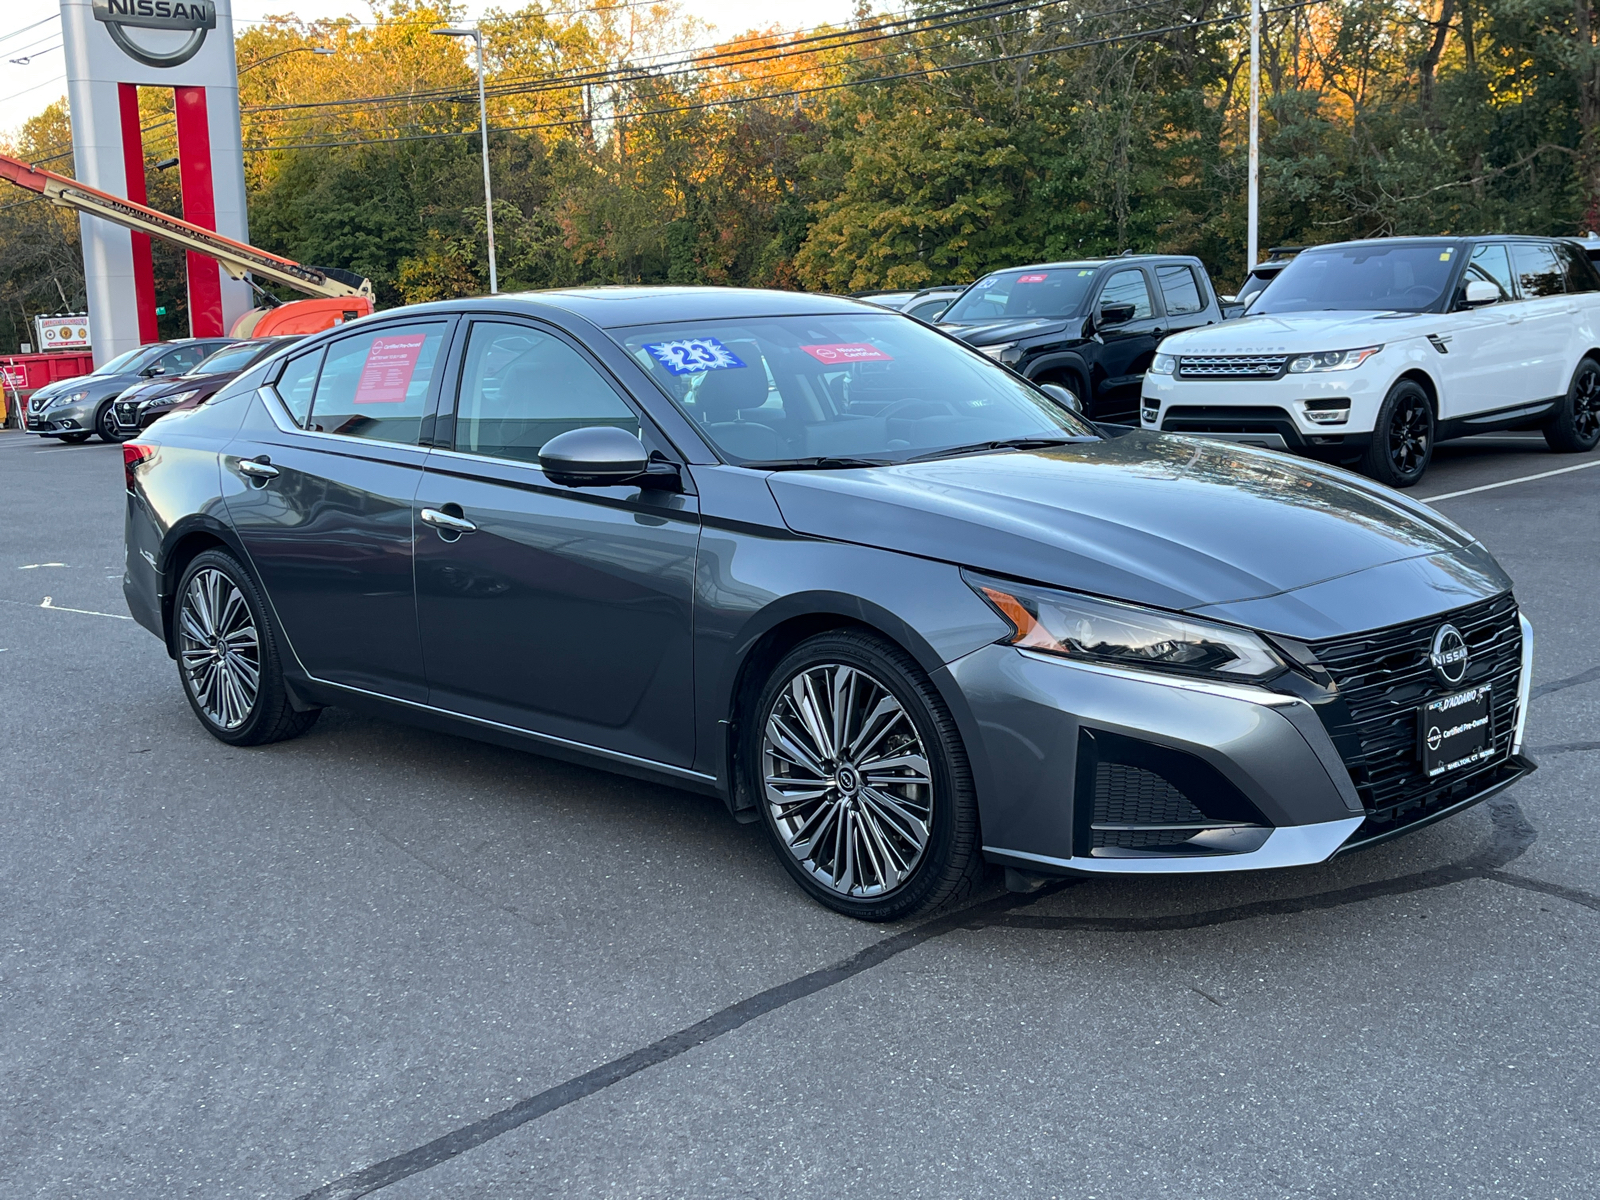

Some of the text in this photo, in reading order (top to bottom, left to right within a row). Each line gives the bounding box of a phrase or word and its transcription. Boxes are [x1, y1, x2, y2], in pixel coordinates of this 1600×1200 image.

[108, 0, 206, 21] NISSAN
[671, 344, 716, 365] 23
[1432, 648, 1468, 666] NISSAN
[1443, 715, 1488, 738] Certified Pre-Owned
